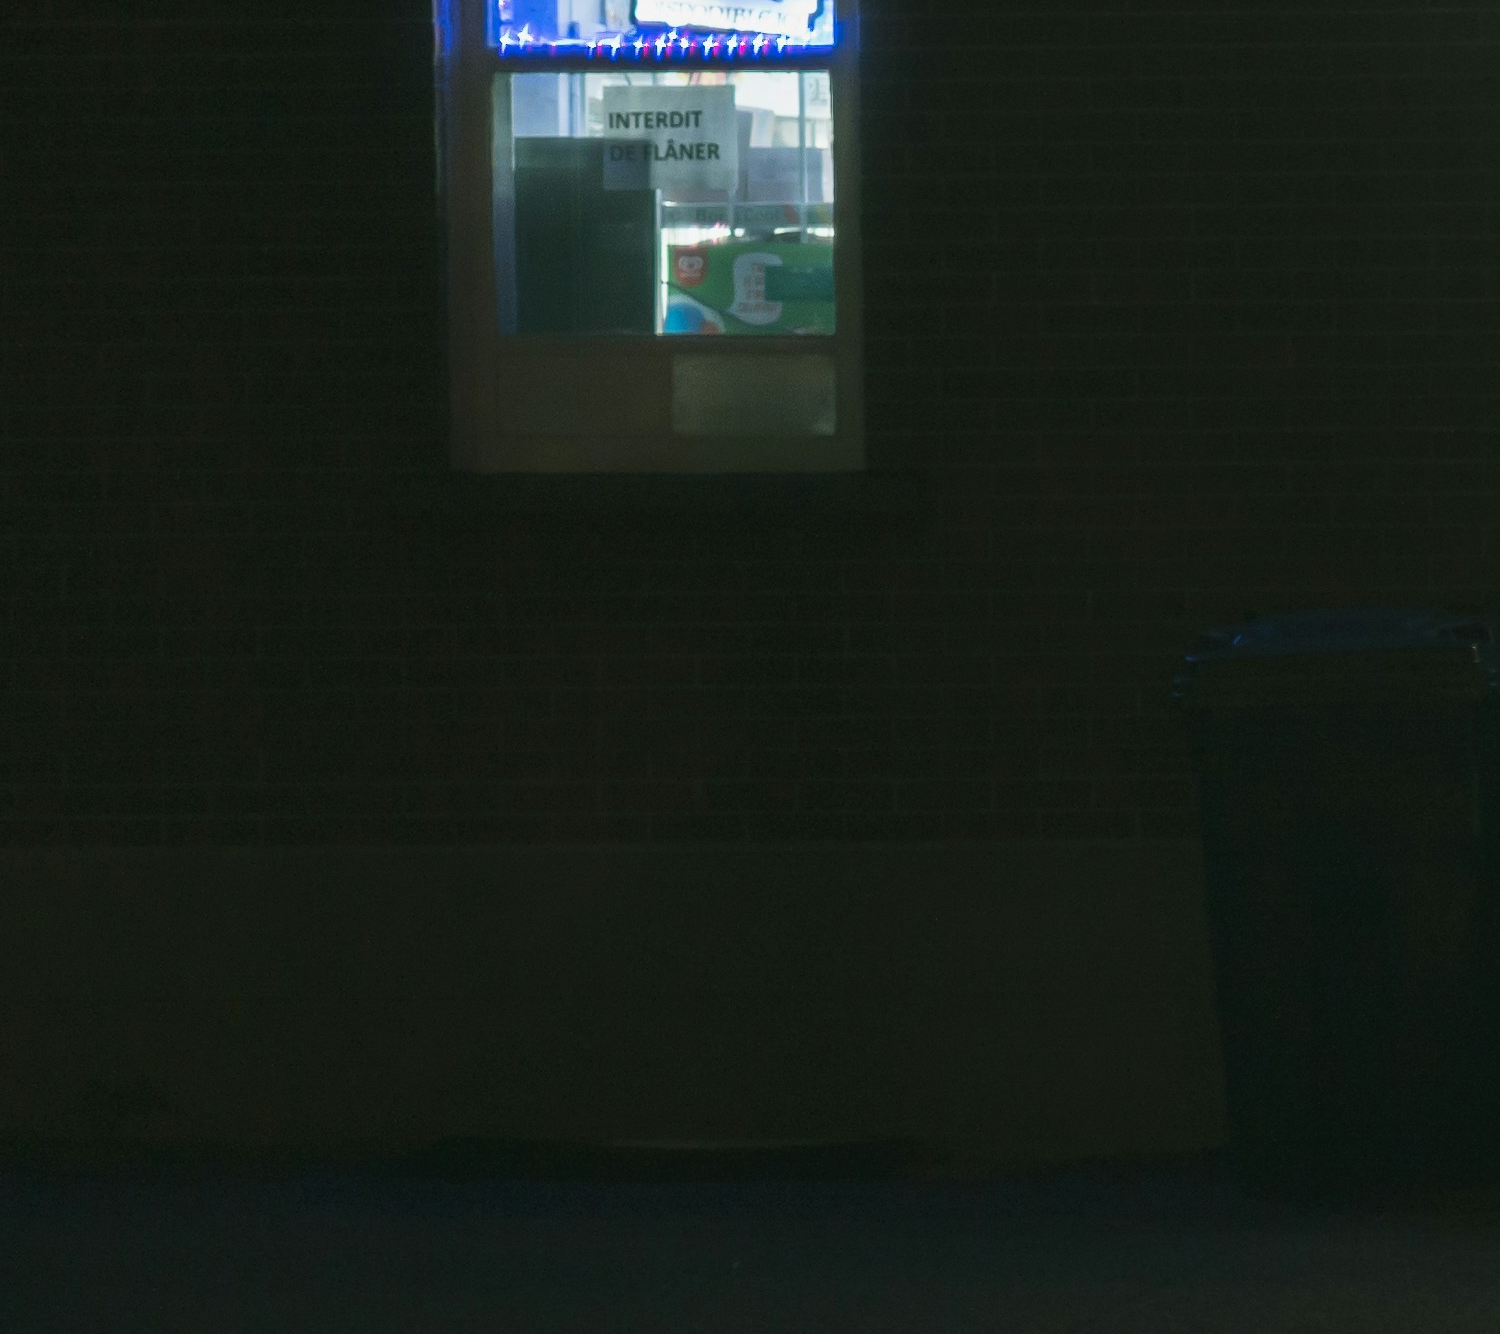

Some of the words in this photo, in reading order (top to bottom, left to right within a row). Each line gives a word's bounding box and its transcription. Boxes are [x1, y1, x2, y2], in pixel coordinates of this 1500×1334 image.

[608, 110, 702, 130] INTERDIT
[609, 142, 635, 161] DE
[640, 138, 720, 161] FLÂNER
